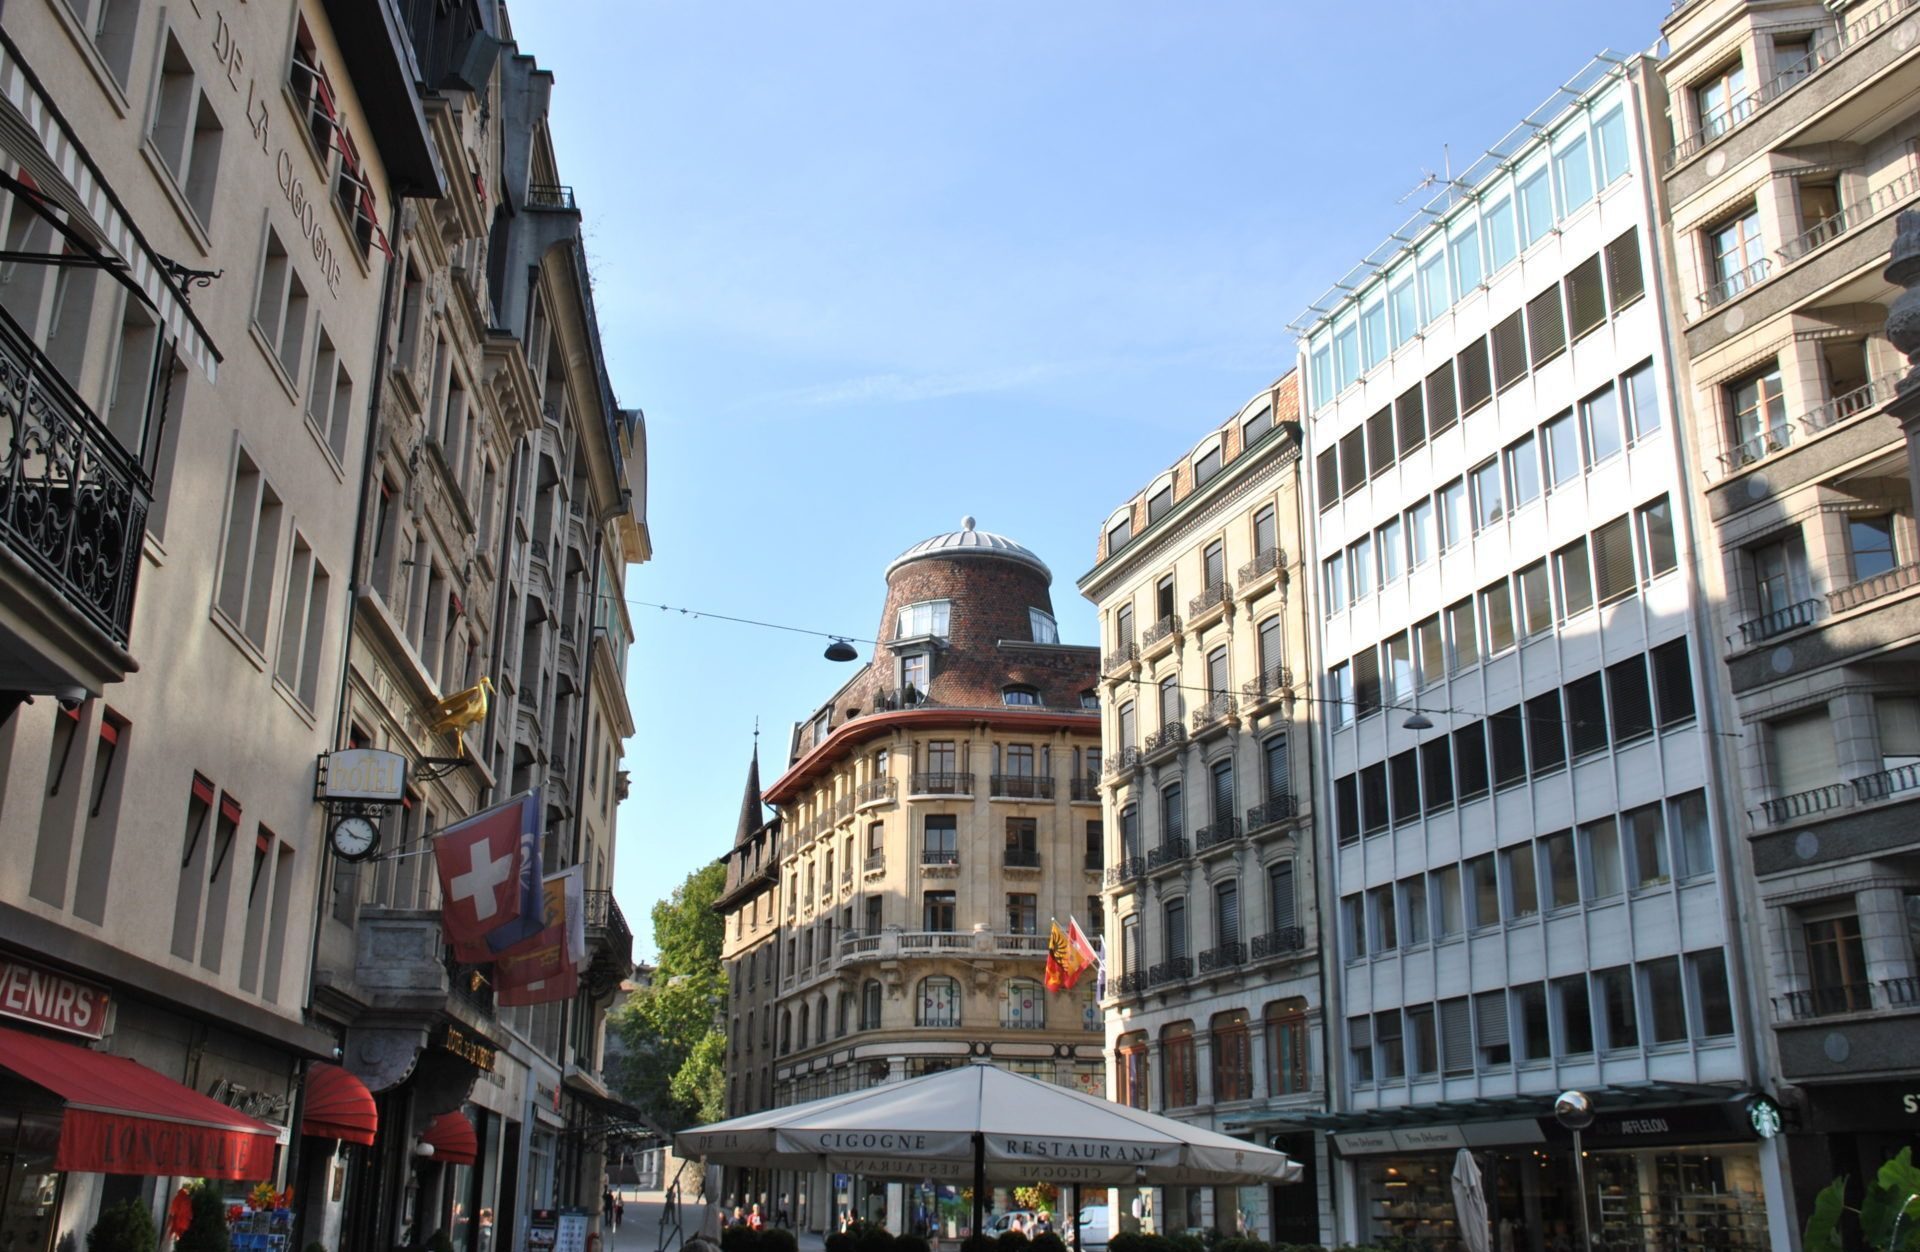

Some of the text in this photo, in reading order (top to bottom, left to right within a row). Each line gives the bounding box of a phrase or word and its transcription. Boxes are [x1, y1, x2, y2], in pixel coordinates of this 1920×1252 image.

[212, 11, 341, 300] DE LA CIGOGNE
[1903, 1094, 1920, 1113] S
[819, 1132, 926, 1150] CIGOGNE
[1006, 1139, 1161, 1162] RESTAURANT
